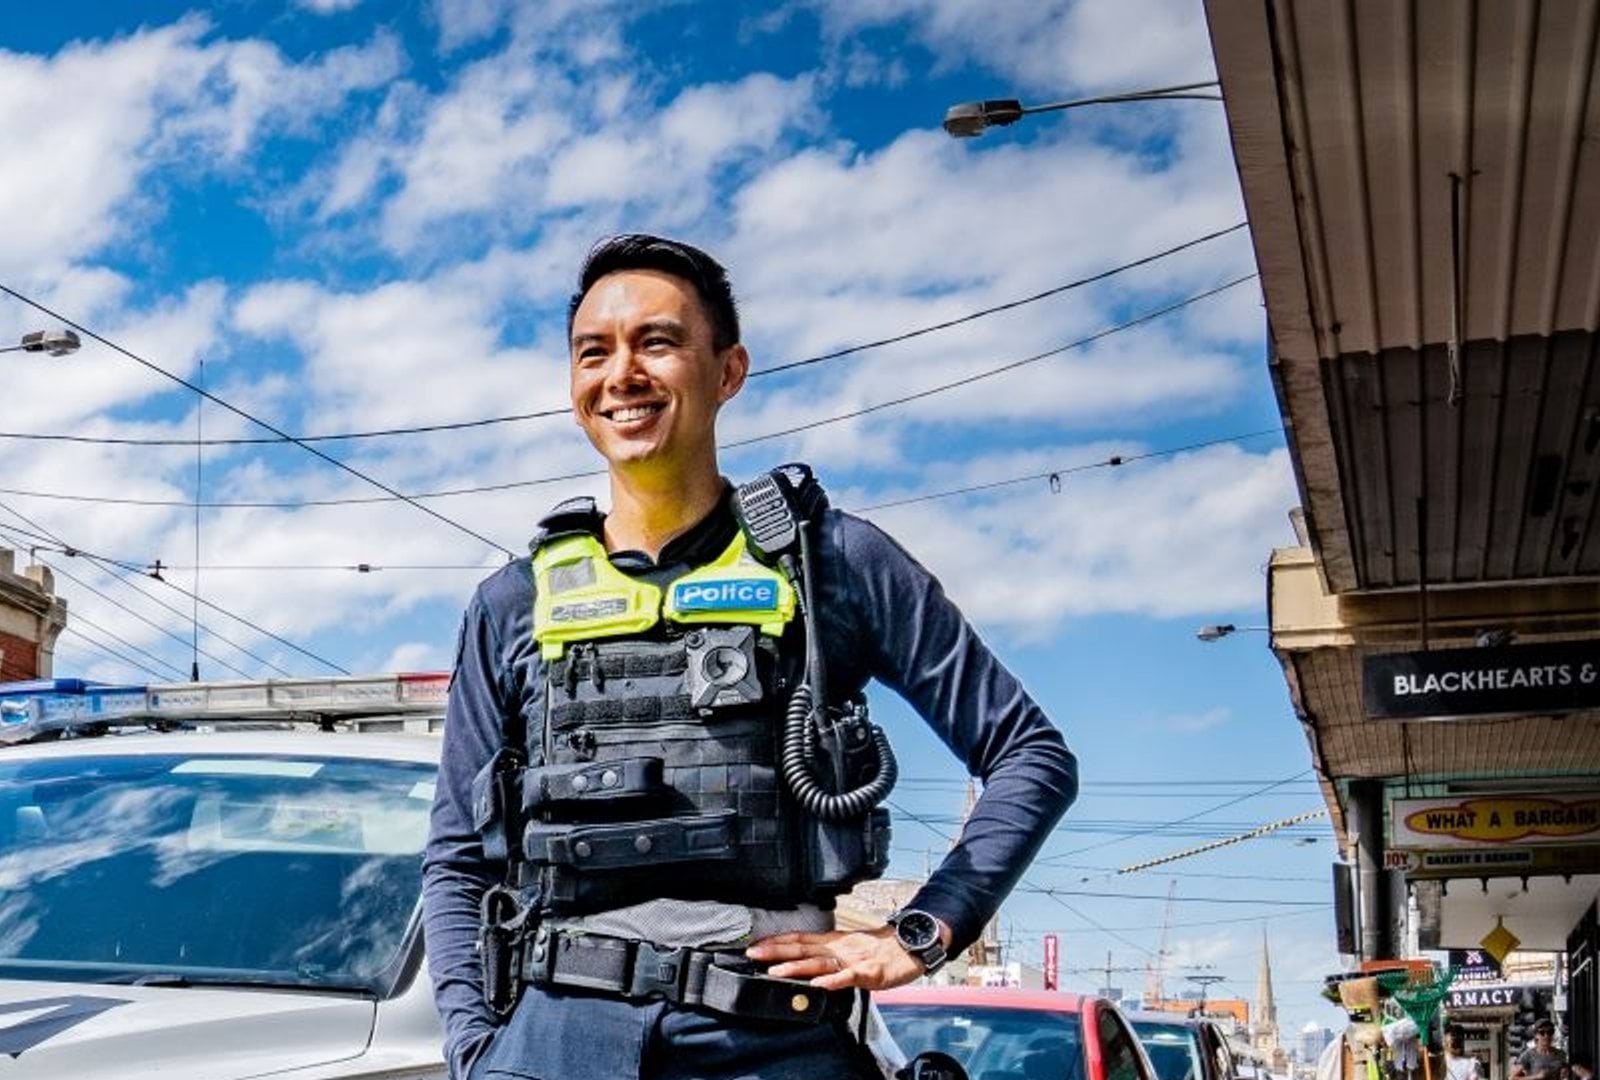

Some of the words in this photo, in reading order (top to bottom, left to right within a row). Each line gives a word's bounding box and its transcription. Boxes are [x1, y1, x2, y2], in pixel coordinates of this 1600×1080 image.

[683, 583, 772, 604] Police
[1394, 664, 1572, 696] BLACKHEARTS
[1579, 664, 1596, 684] &
[1426, 812, 1477, 829] WHAT
[1490, 814, 1501, 828] A
[1446, 989, 1514, 1007] RMACY
